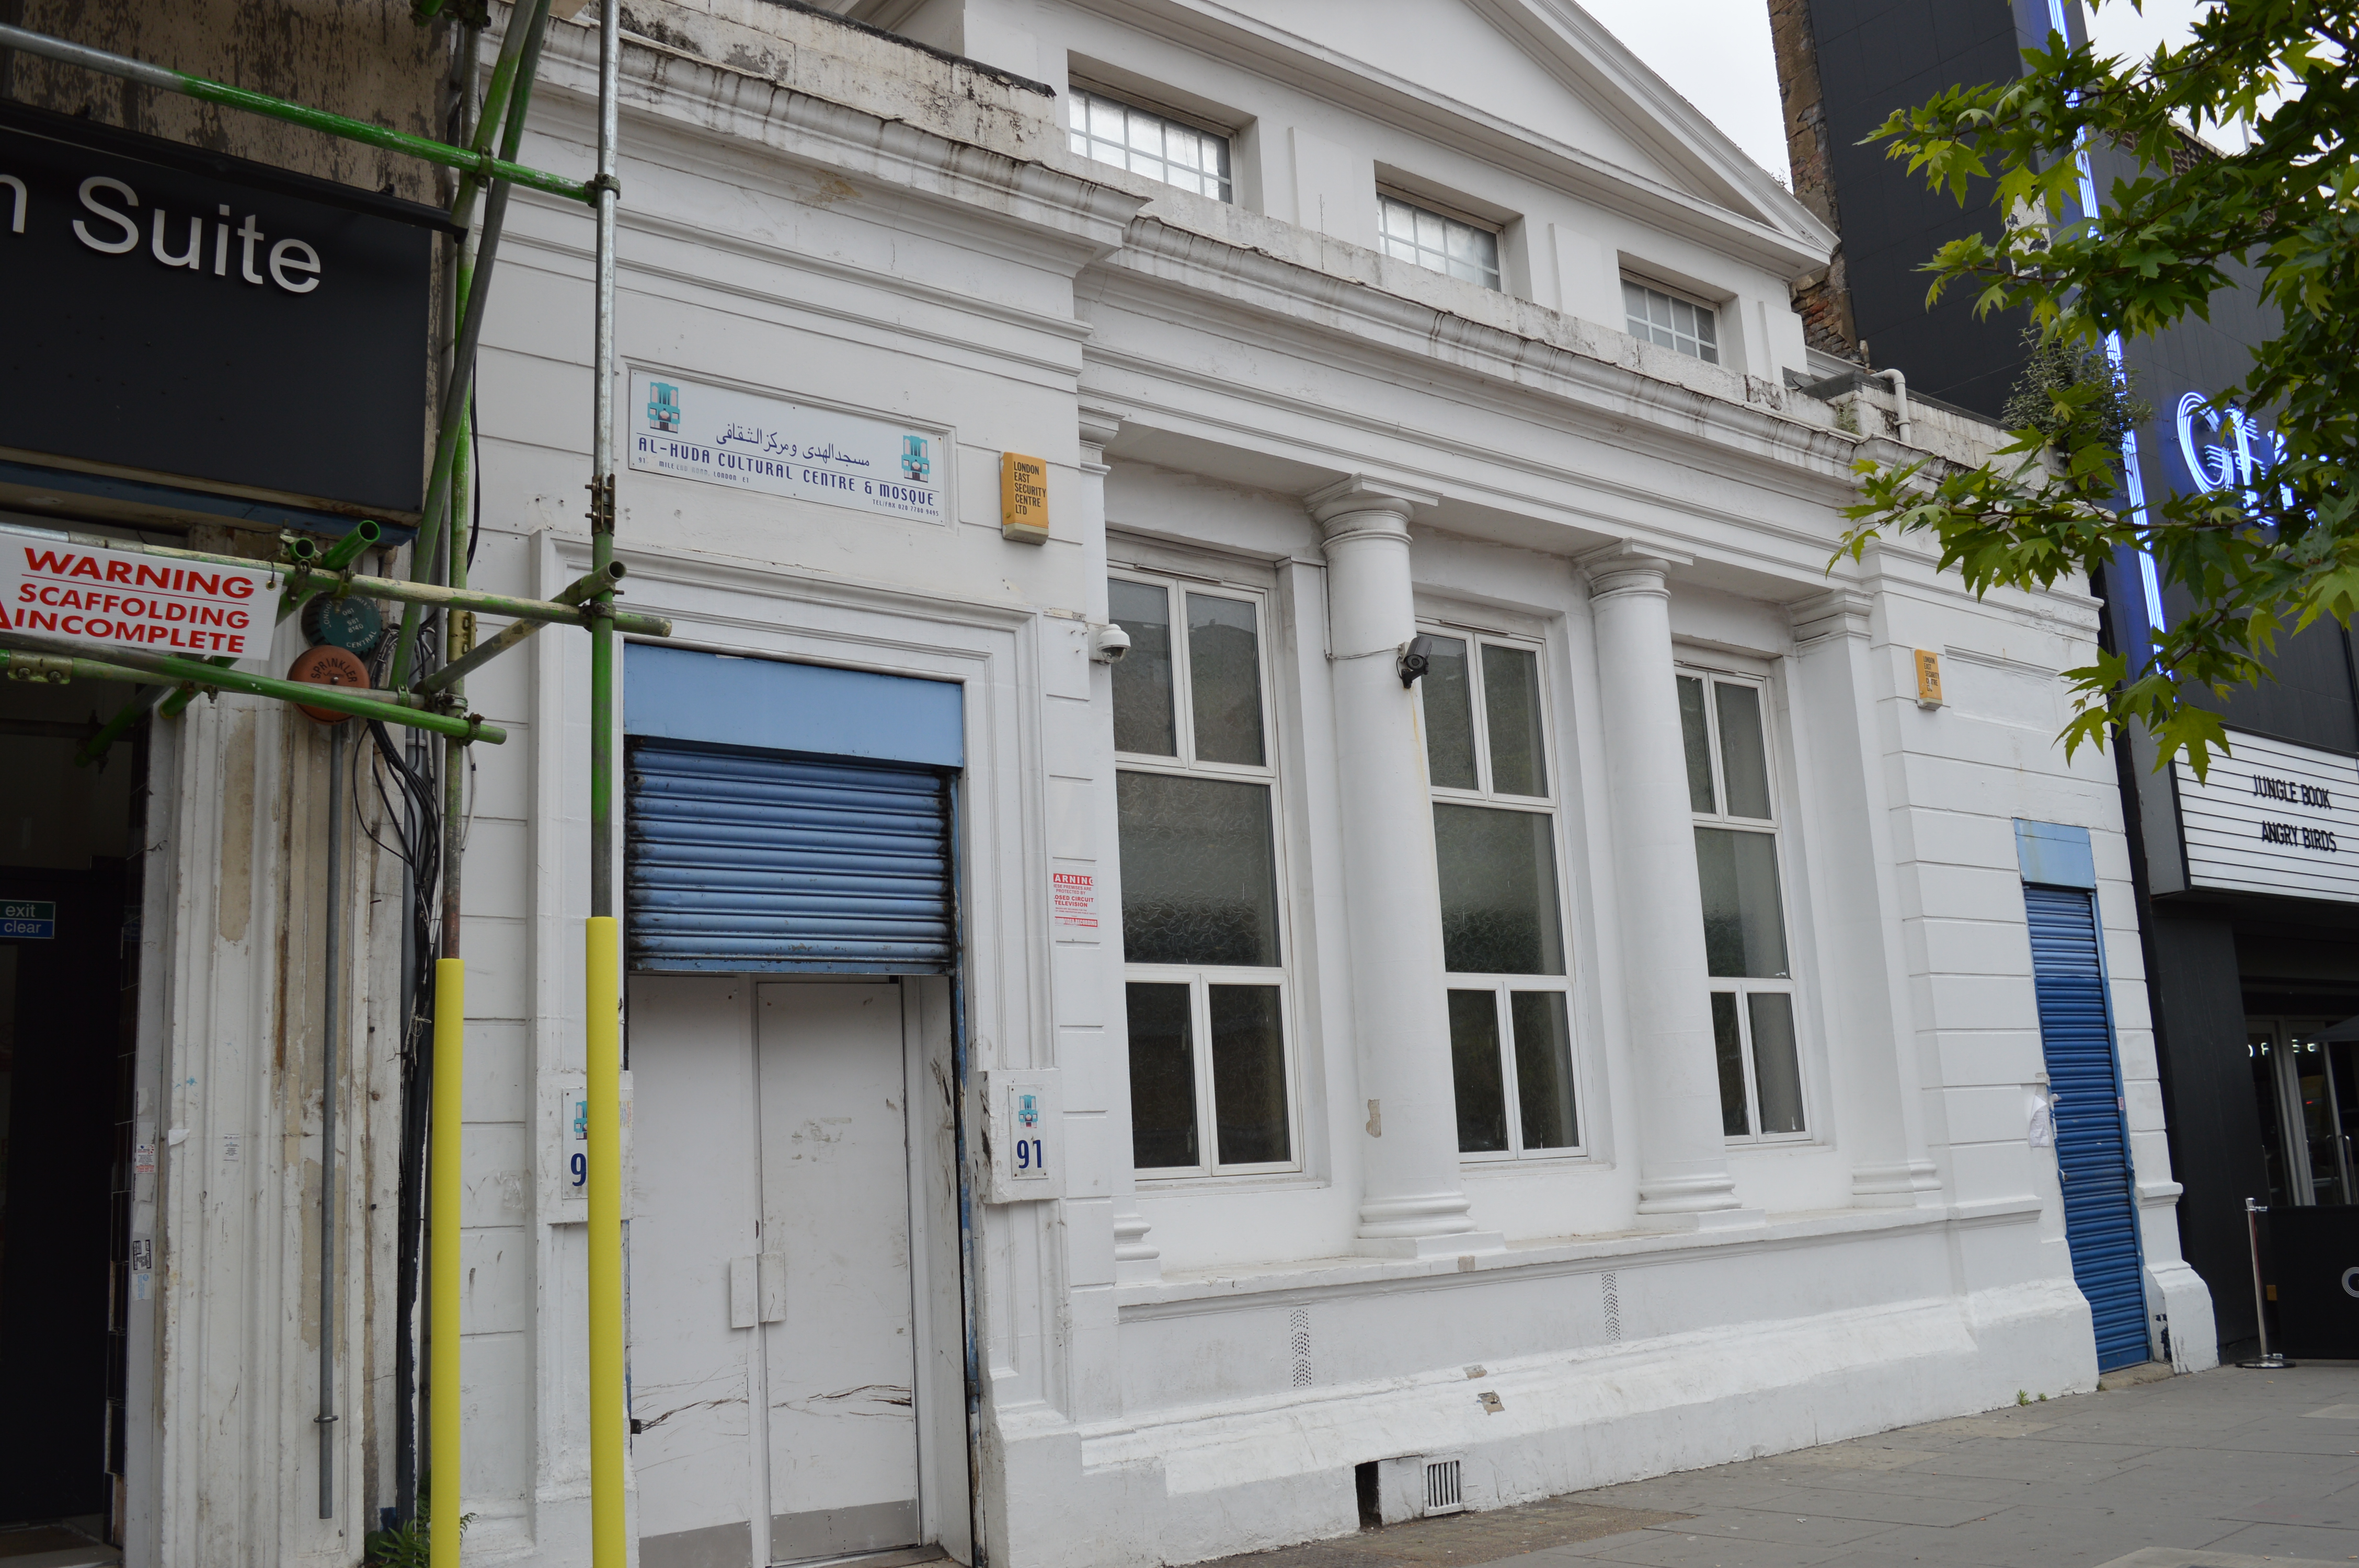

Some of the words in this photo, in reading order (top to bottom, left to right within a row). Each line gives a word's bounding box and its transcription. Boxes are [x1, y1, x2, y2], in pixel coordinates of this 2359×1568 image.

[72, 176, 321, 293] Suite
[639, 437, 710, 464] AL-HUDA
[718, 453, 793, 480] CULTURAL
[803, 469, 855, 491] CENTRE
[864, 481, 872, 494] &
[879, 483, 934, 506] MOSQUE
[659, 460, 674, 469] MILE
[714, 471, 737, 481] LONDON
[1013, 461, 1039, 476] LONDON
[1014, 471, 1030, 483] EAST
[1014, 482, 1046, 498] SECURITY
[873, 499, 896, 509] TEL/FAX
[1015, 493, 1041, 508] CENTRE
[1015, 504, 1027, 515] LTD
[24, 547, 255, 599] WARNING
[18, 583, 250, 629] SCAFFOLDING
[15, 608, 246, 654] INCOMPLETE
[347, 618, 359, 626] 981
[348, 624, 363, 633] 8140
[346, 631, 377, 648] CENTRAL
[311, 658, 358, 683] SPRINKLER
[2253, 774, 2298, 803] JUNGLE
[2300, 783, 2332, 810] BOOK
[2262, 820, 2298, 847] ANGRY
[2302, 827, 2337, 852] BIRDS
[5, 904, 36, 917] exit
[4, 920, 41, 933] clear
[1017, 1139, 1042, 1169] 91
[570, 1153, 587, 1186] 9
